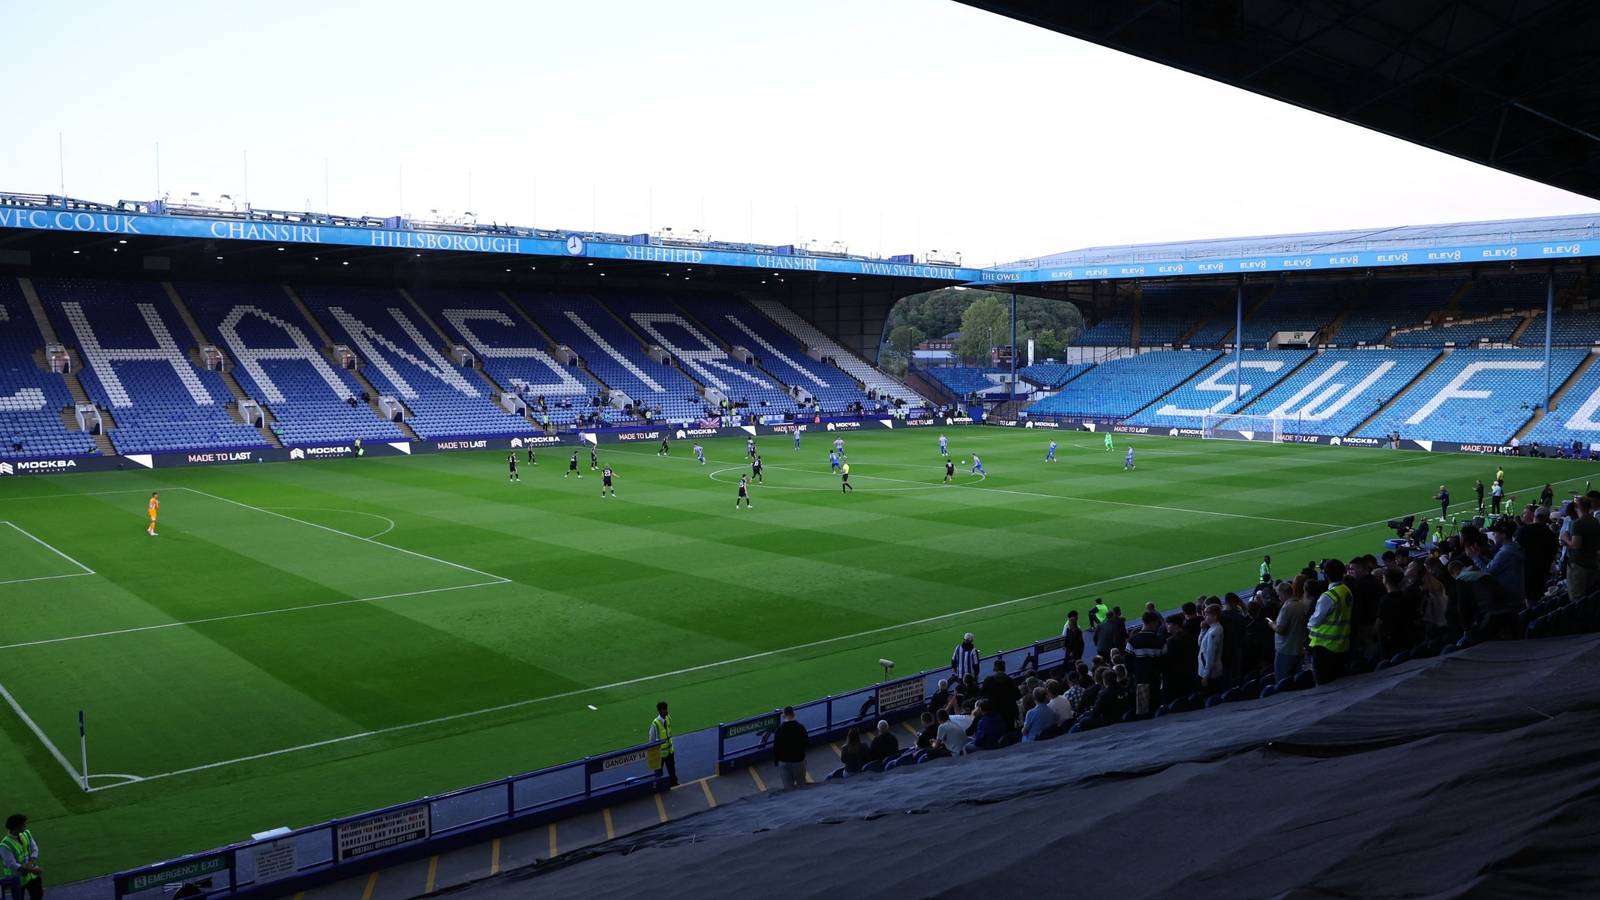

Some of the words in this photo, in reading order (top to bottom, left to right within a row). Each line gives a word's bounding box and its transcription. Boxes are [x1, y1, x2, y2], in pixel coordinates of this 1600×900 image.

[211, 221, 321, 242] CHANSIRI
[371, 231, 521, 253] HILLSBOROUGH
[1483, 247, 1517, 257] ELEV8
[1543, 244, 1580, 254] ELEV8
[626, 246, 702, 263] SHEFFIELD
[1330, 255, 1358, 264] ELEV8
[1377, 252, 1408, 262] ELEV8
[1429, 250, 1460, 260] ELEV8
[756, 255, 817, 270] CHANSIRI
[1199, 262, 1223, 271] ELEV8
[1240, 260, 1266, 269] ELEV8
[1284, 257, 1311, 267] ELEV8
[861, 262, 955, 279] WWW.SWFC.CO.UK
[1086, 268, 1108, 276] ELEV8
[1121, 266, 1144, 274] ELEV8
[1159, 264, 1183, 272] ELEV8
[982, 272, 994, 280] THE
[996, 272, 1020, 280] OWLS
[1051, 270, 1073, 279] ELEV8
[437, 441, 459, 449] MADE
[469, 440, 487, 448] LAST
[1343, 437, 1378, 445] MOCKBA
[307, 446, 352, 455] MOCKBA
[188, 454, 214, 462] MADE
[215, 453, 228, 461] TO
[229, 451, 251, 460] LAST
[17, 460, 76, 469] MOCKBA
[605, 754, 637, 768] GANGWAY
[638, 752, 646, 761] 14
[148, 865, 198, 884] EMERGENCY
[201, 858, 219, 870] EXIT
